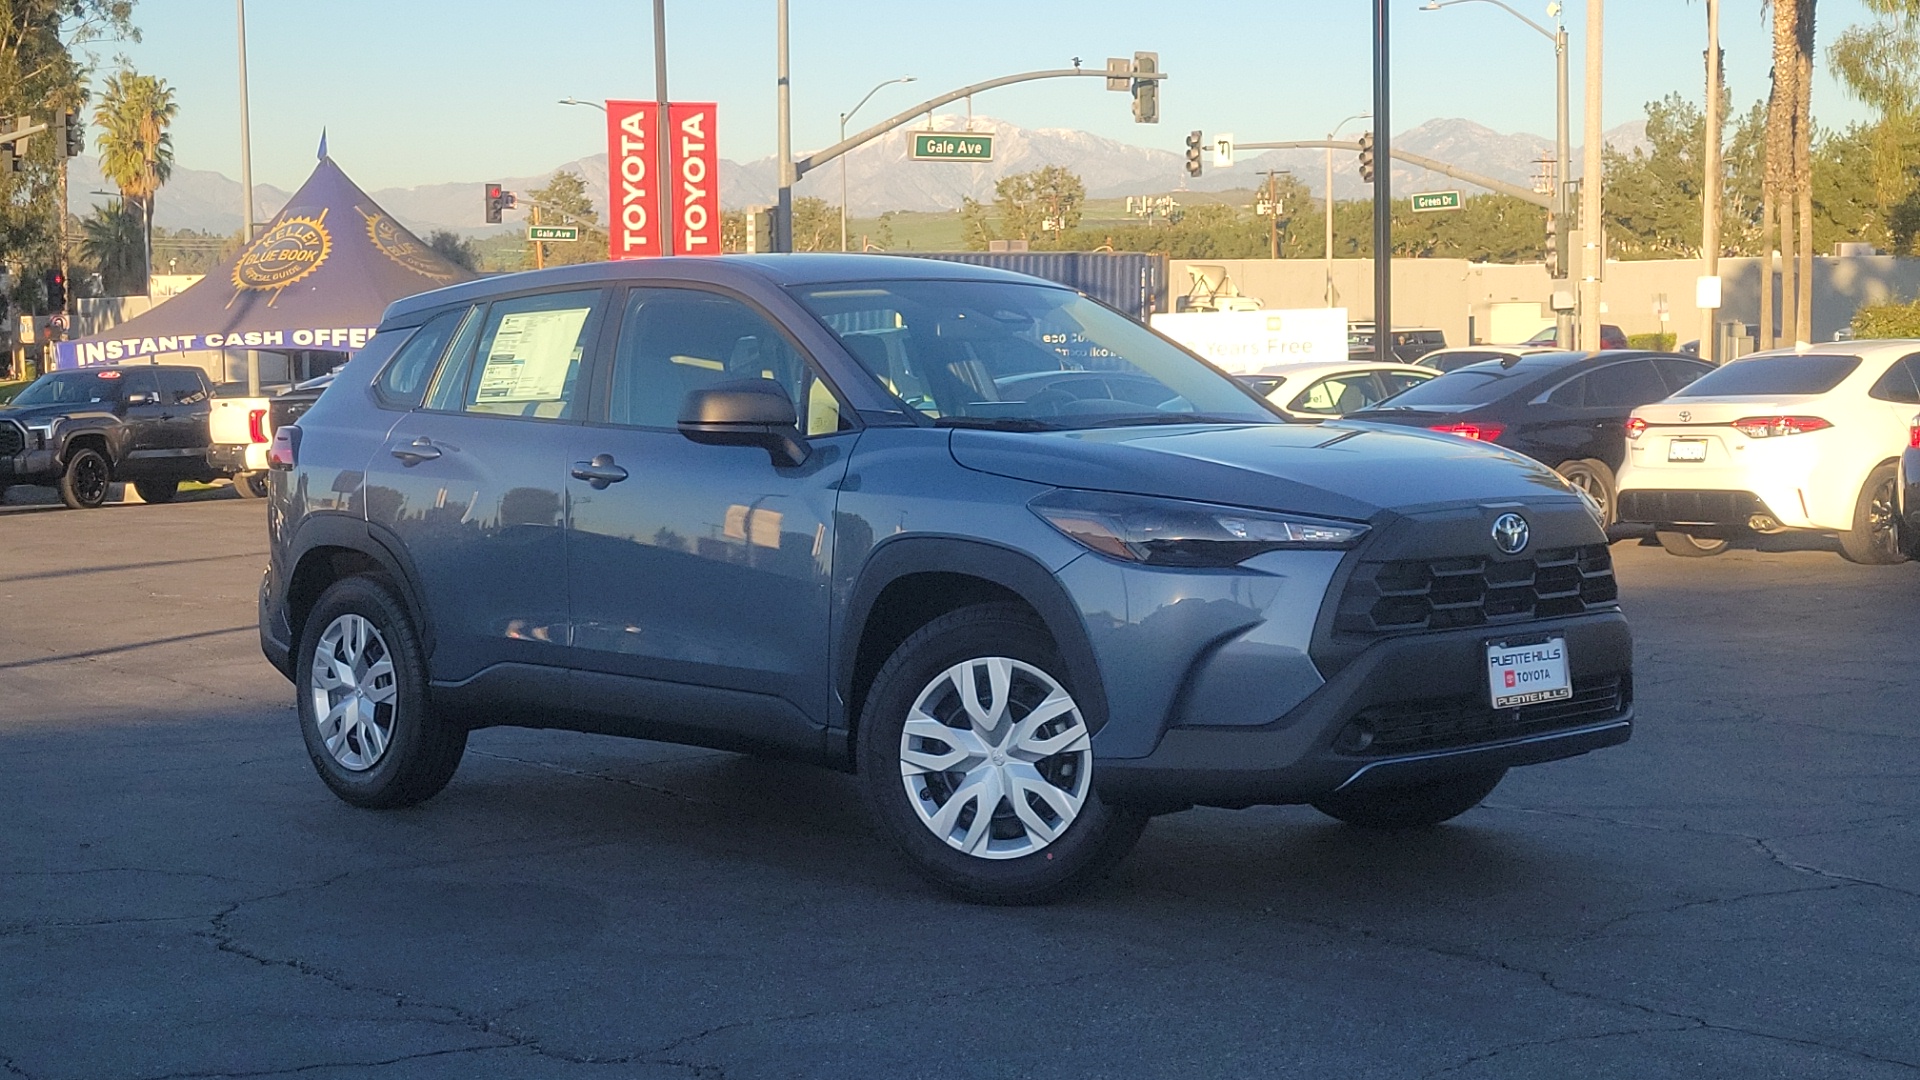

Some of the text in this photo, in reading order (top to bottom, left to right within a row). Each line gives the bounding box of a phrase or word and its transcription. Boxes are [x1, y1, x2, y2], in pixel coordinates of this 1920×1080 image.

[927, 139, 982, 154] Gale Ave
[621, 111, 647, 251] TOYOTA
[681, 112, 708, 251] TOYOTA
[1419, 195, 1452, 207] Green Dr
[263, 226, 320, 248] KELLEY
[537, 229, 571, 238] Gale Ave
[244, 249, 319, 265] BLUE BOOK
[272, 265, 302, 280] GUIDE
[76, 334, 197, 366] INSTANT
[205, 330, 284, 347] CASH
[1206, 341, 1259, 356] Years
[1267, 338, 1313, 354] Free
[1491, 648, 1561, 668] PUENTE HILLS
[1516, 669, 1551, 683] TOYOTA
[1498, 689, 1568, 706] PUENTE HILLS
